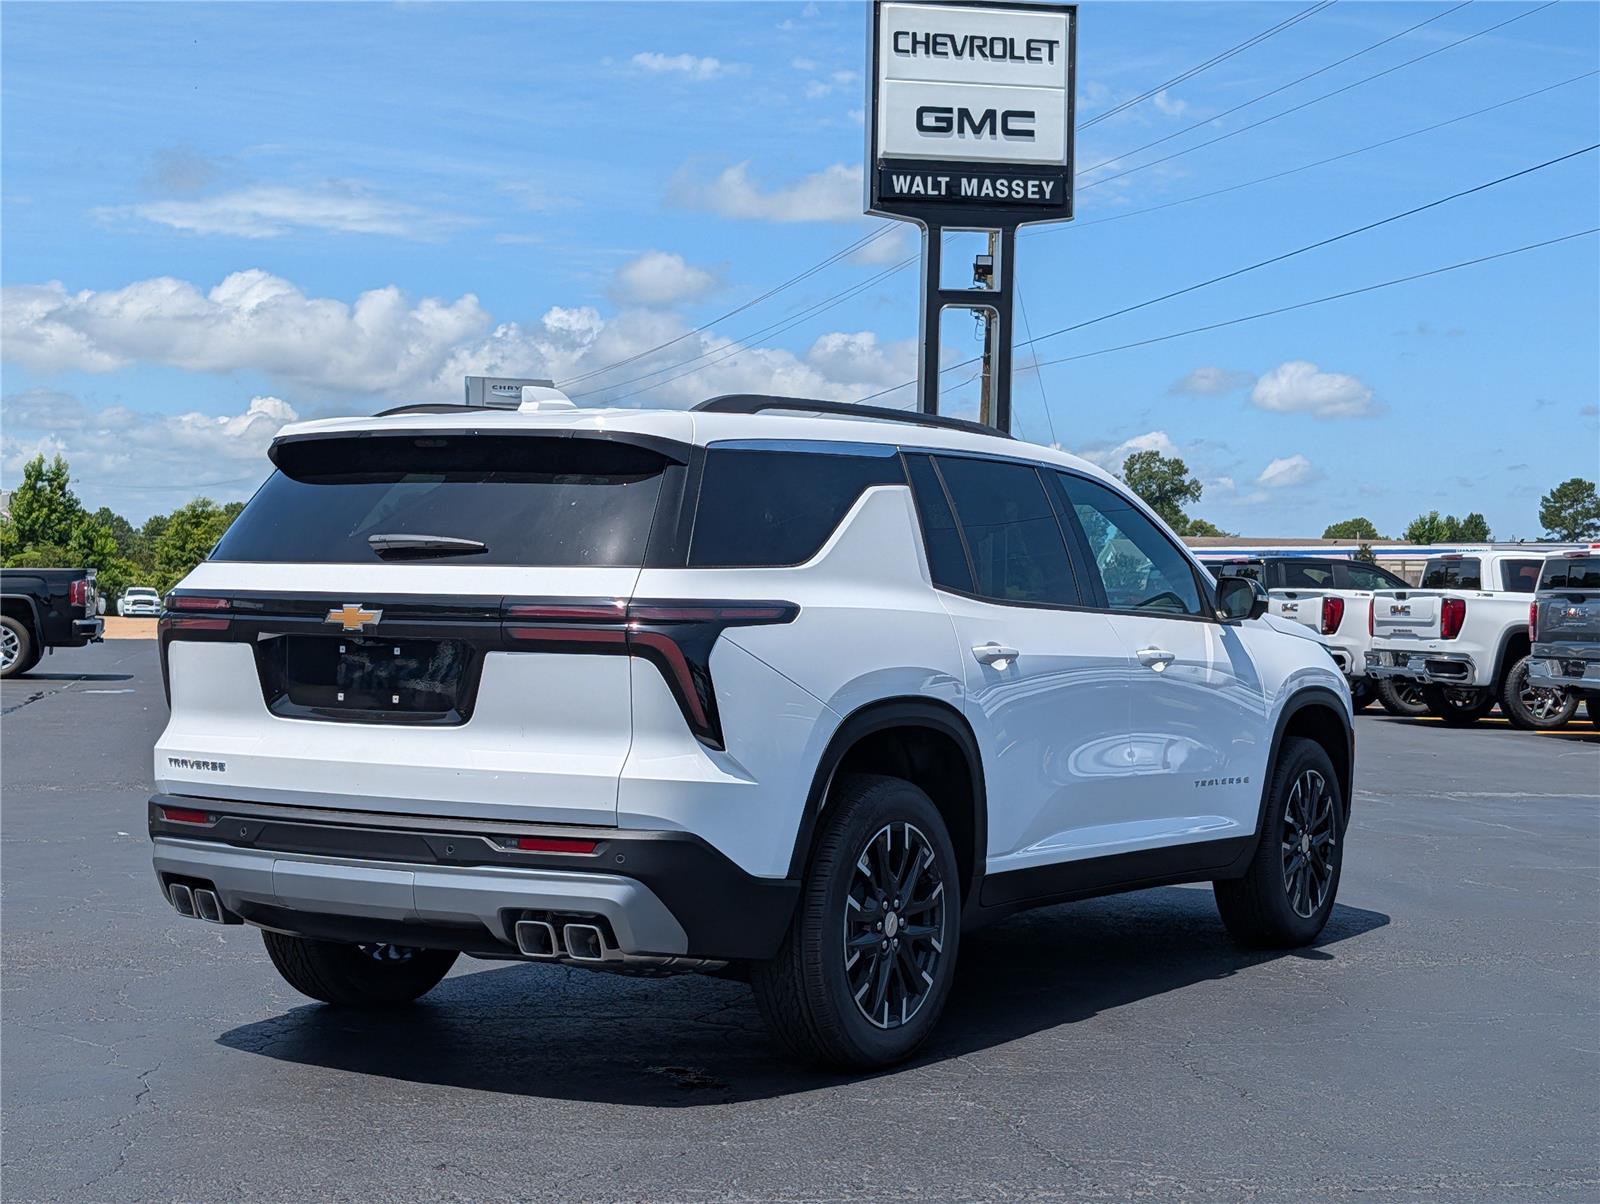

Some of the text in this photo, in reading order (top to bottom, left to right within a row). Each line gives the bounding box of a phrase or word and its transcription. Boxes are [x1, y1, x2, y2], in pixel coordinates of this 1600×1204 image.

[893, 30, 1060, 63] CHEVROLET
[915, 105, 1036, 139] GMC
[892, 174, 1055, 200] WALT MASSEY
[168, 758, 226, 772] TRAVERSE
[1194, 776, 1250, 788] TRAVERSE
